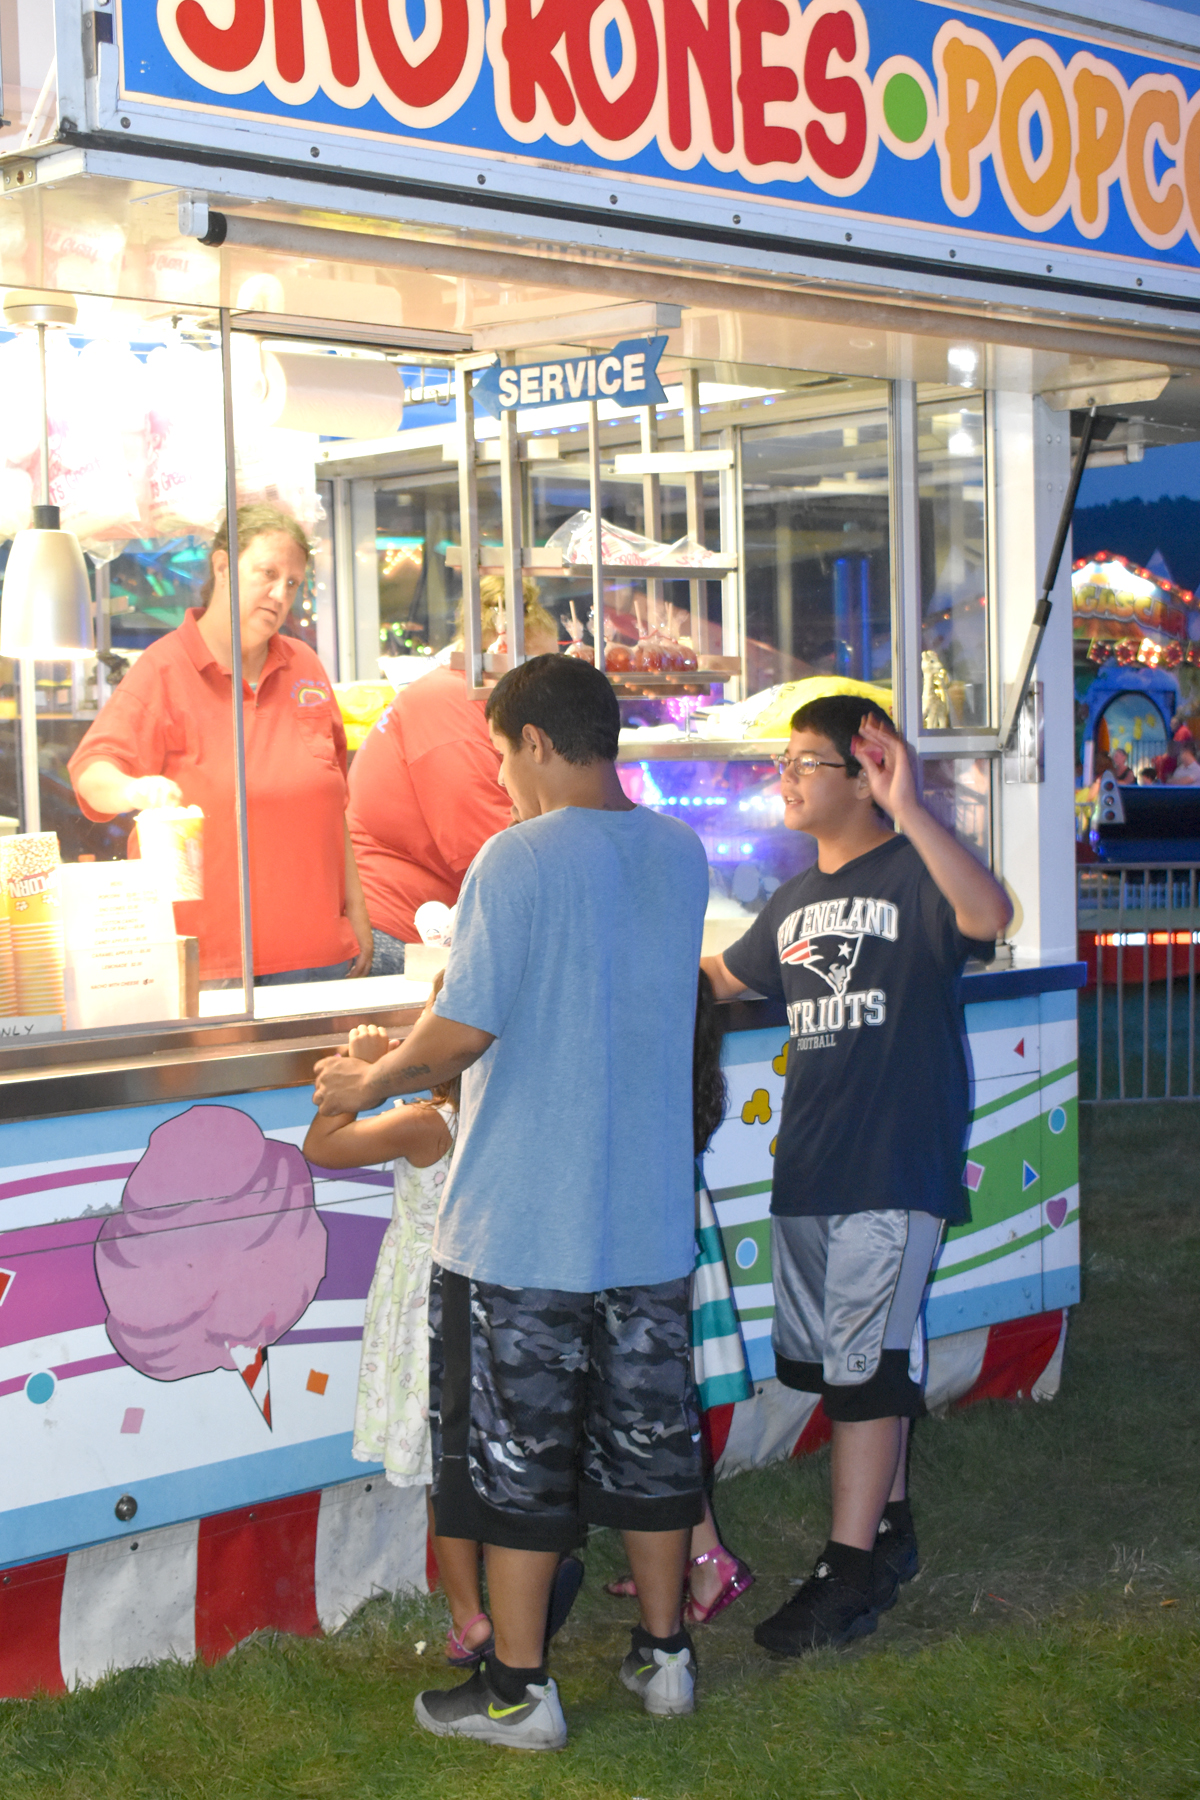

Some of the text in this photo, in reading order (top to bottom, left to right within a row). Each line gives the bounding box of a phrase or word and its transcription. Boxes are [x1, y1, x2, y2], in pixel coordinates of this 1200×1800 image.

[502, 0, 868, 180] KONES
[942, 36, 1200, 242] POPC
[498, 353, 646, 407] SERVICE
[800, 897, 899, 942] ENGLAND
[797, 1034, 837, 1051] FOOTBALL
